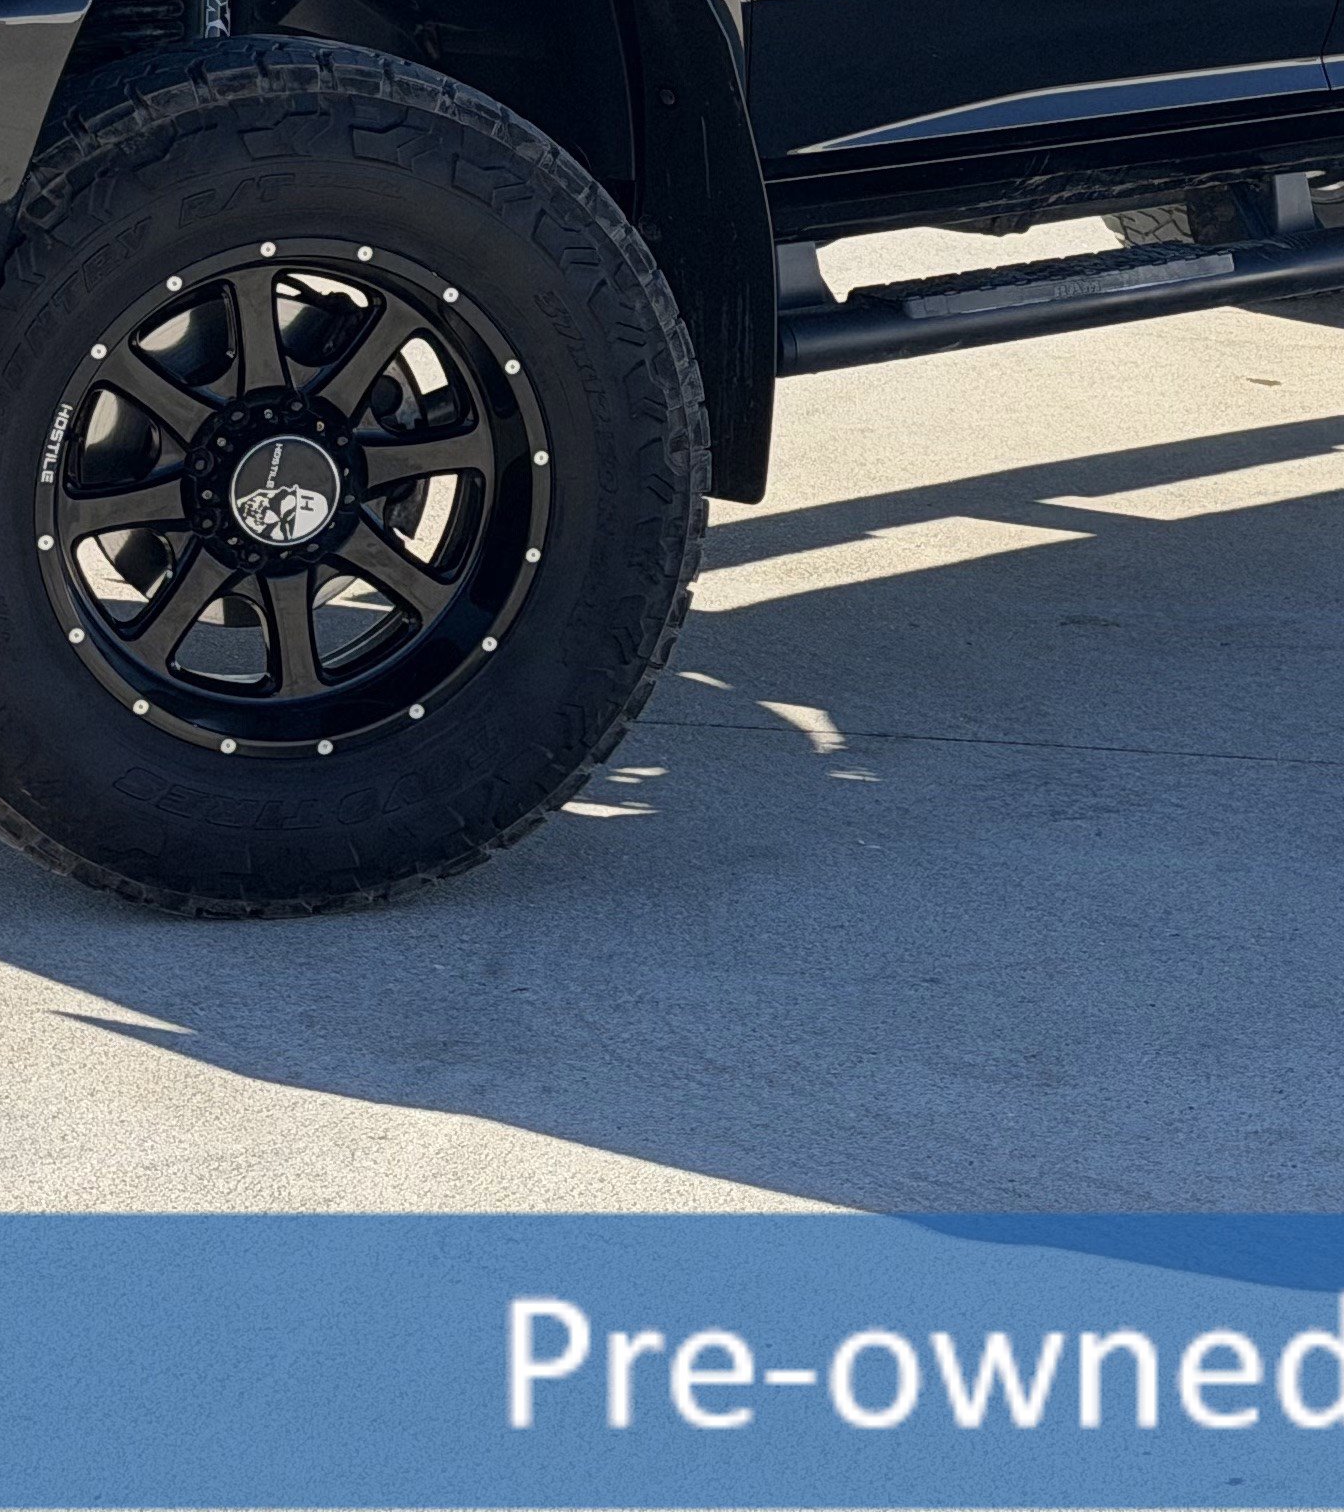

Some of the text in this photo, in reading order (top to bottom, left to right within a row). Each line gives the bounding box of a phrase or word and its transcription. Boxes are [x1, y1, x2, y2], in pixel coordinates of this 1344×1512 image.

[41, 403, 74, 484] HOSTILE
[265, 442, 284, 489] HOSTILE
[299, 494, 315, 512] H
